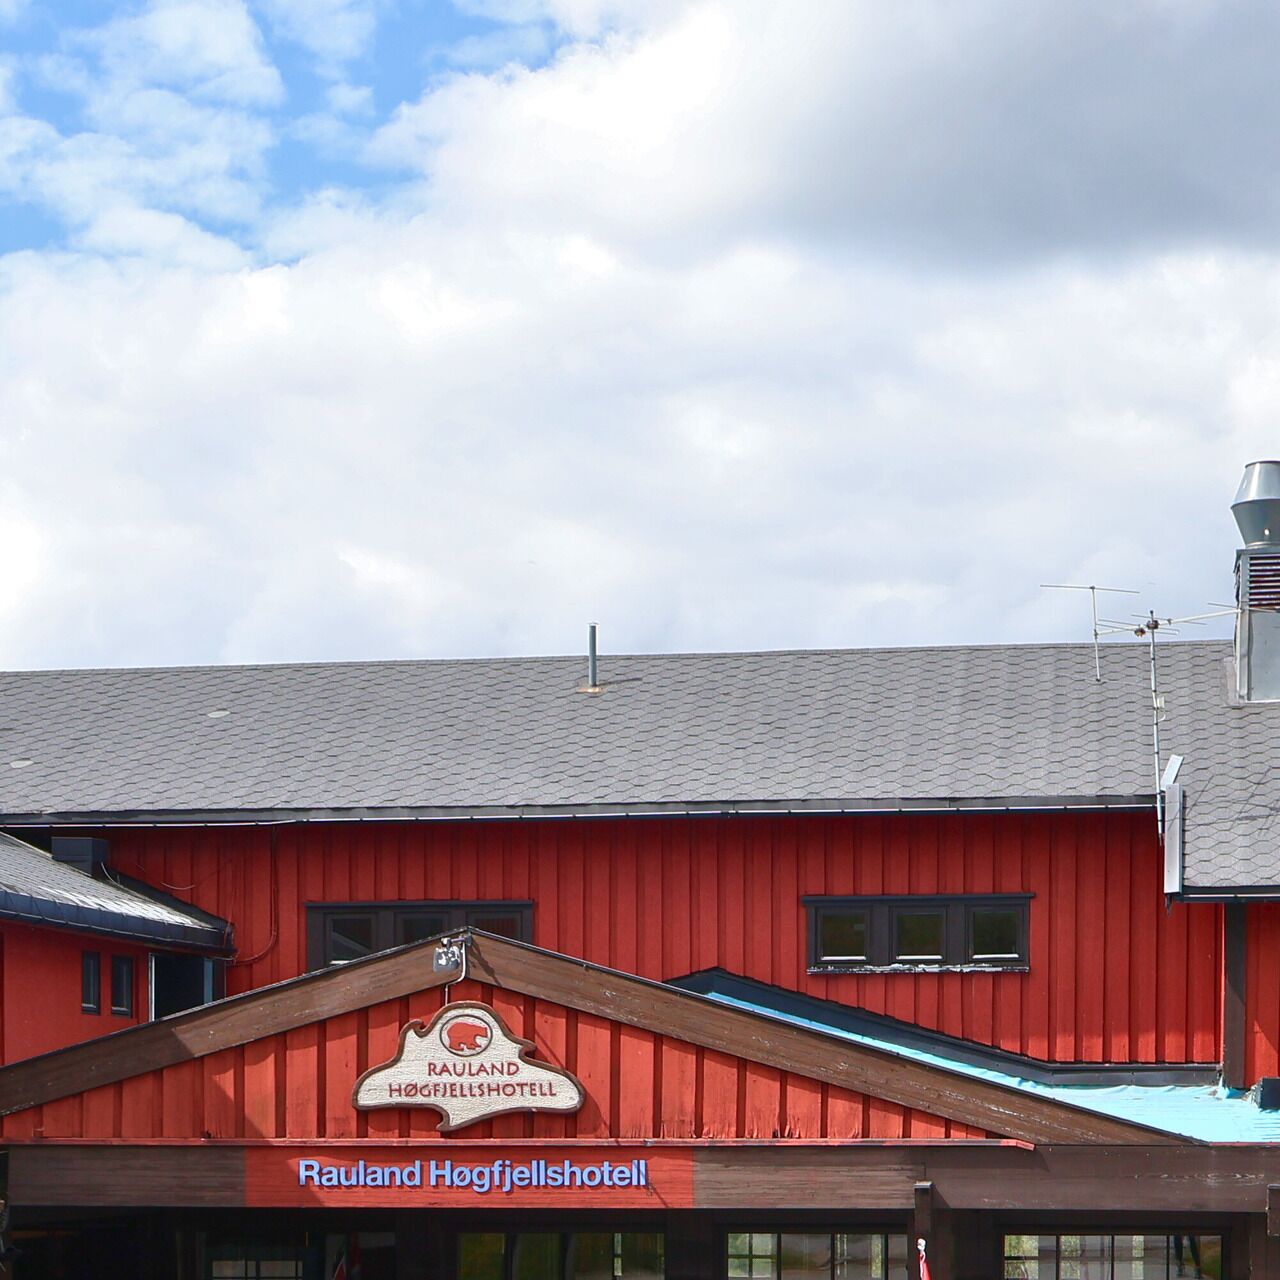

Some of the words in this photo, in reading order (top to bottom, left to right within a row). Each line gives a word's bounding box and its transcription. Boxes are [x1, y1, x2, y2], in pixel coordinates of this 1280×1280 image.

[427, 1061, 520, 1077] RAULAND
[388, 1081, 558, 1099] HØGFJELLSHOTELL
[298, 1159, 421, 1187] Rauland
[429, 1159, 647, 1193] Høgfjellshotell
